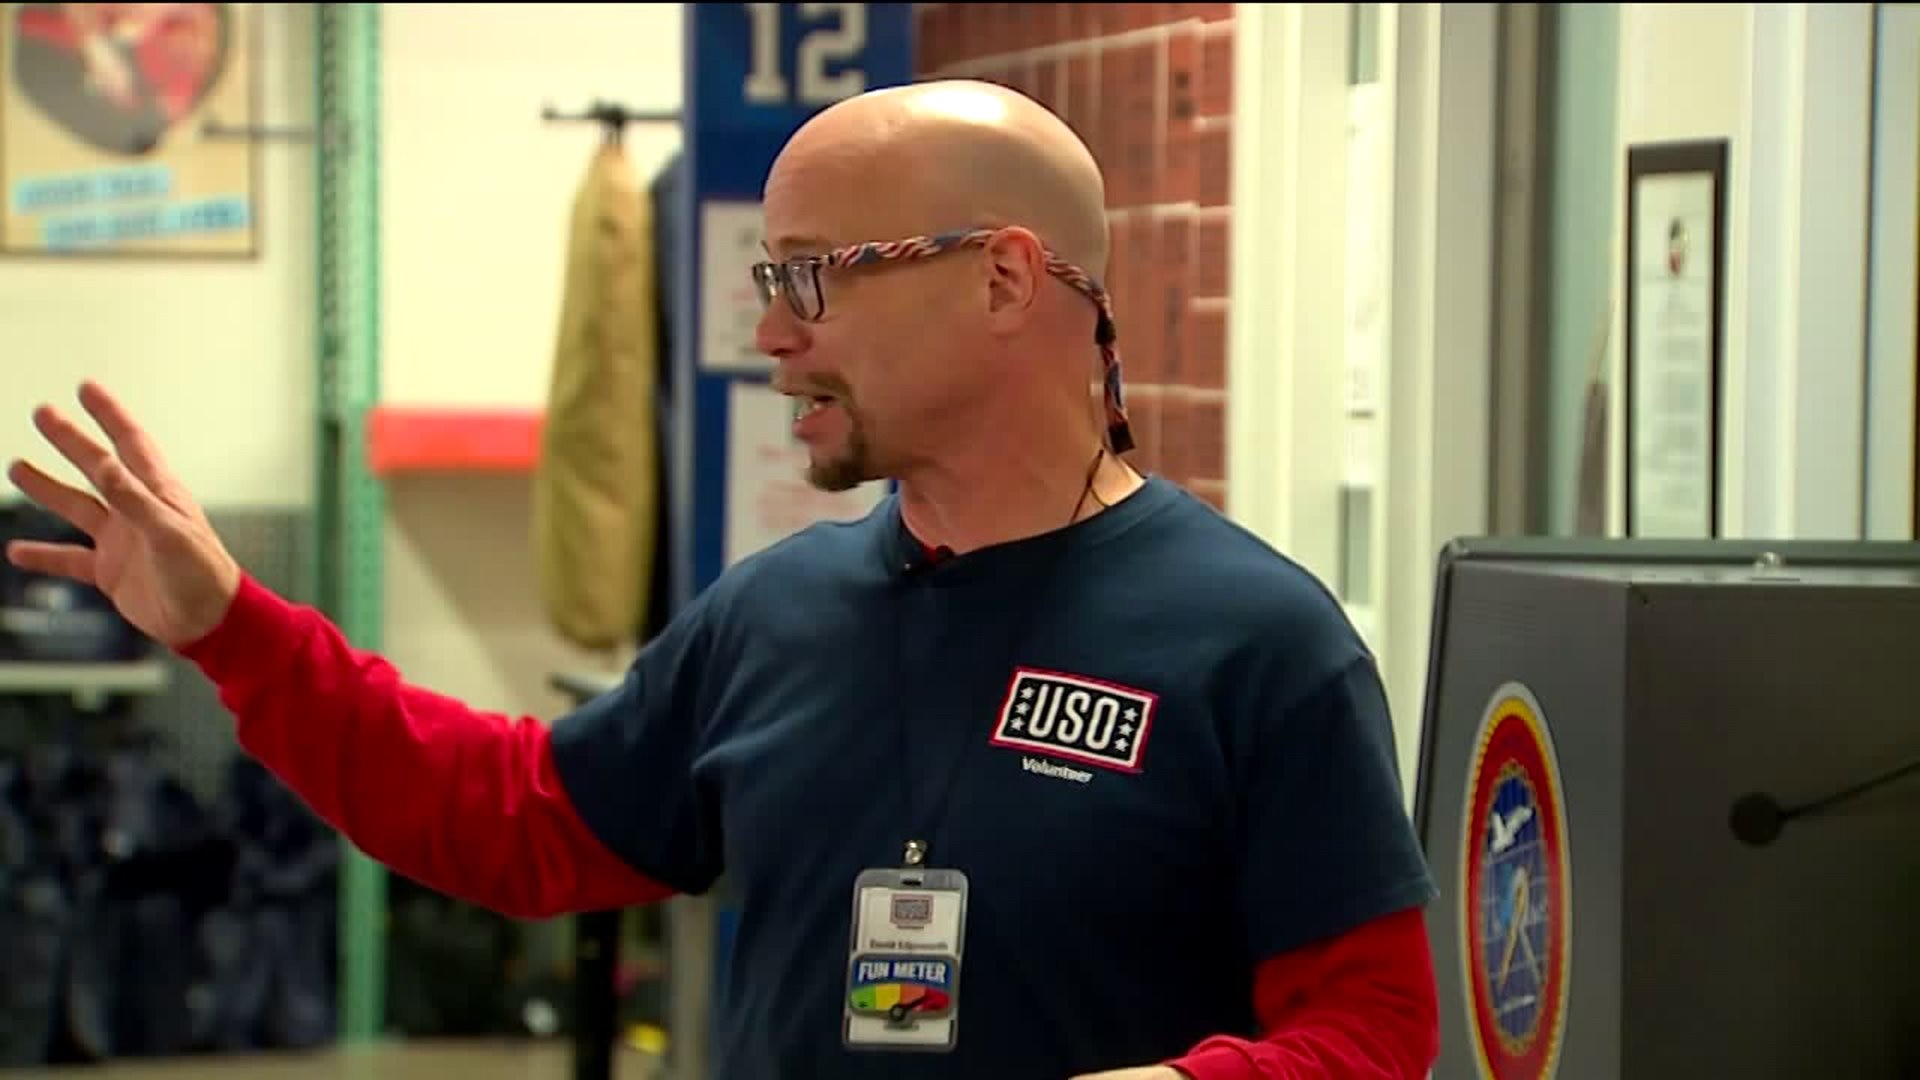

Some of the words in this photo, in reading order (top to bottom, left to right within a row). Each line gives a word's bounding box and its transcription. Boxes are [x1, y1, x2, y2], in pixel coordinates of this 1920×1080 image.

[743, 3, 866, 102] 12
[1028, 683, 1121, 751] USO
[1021, 756, 1094, 784] Volunteer
[858, 961, 890, 982] FUN
[893, 962, 946, 984] METER
